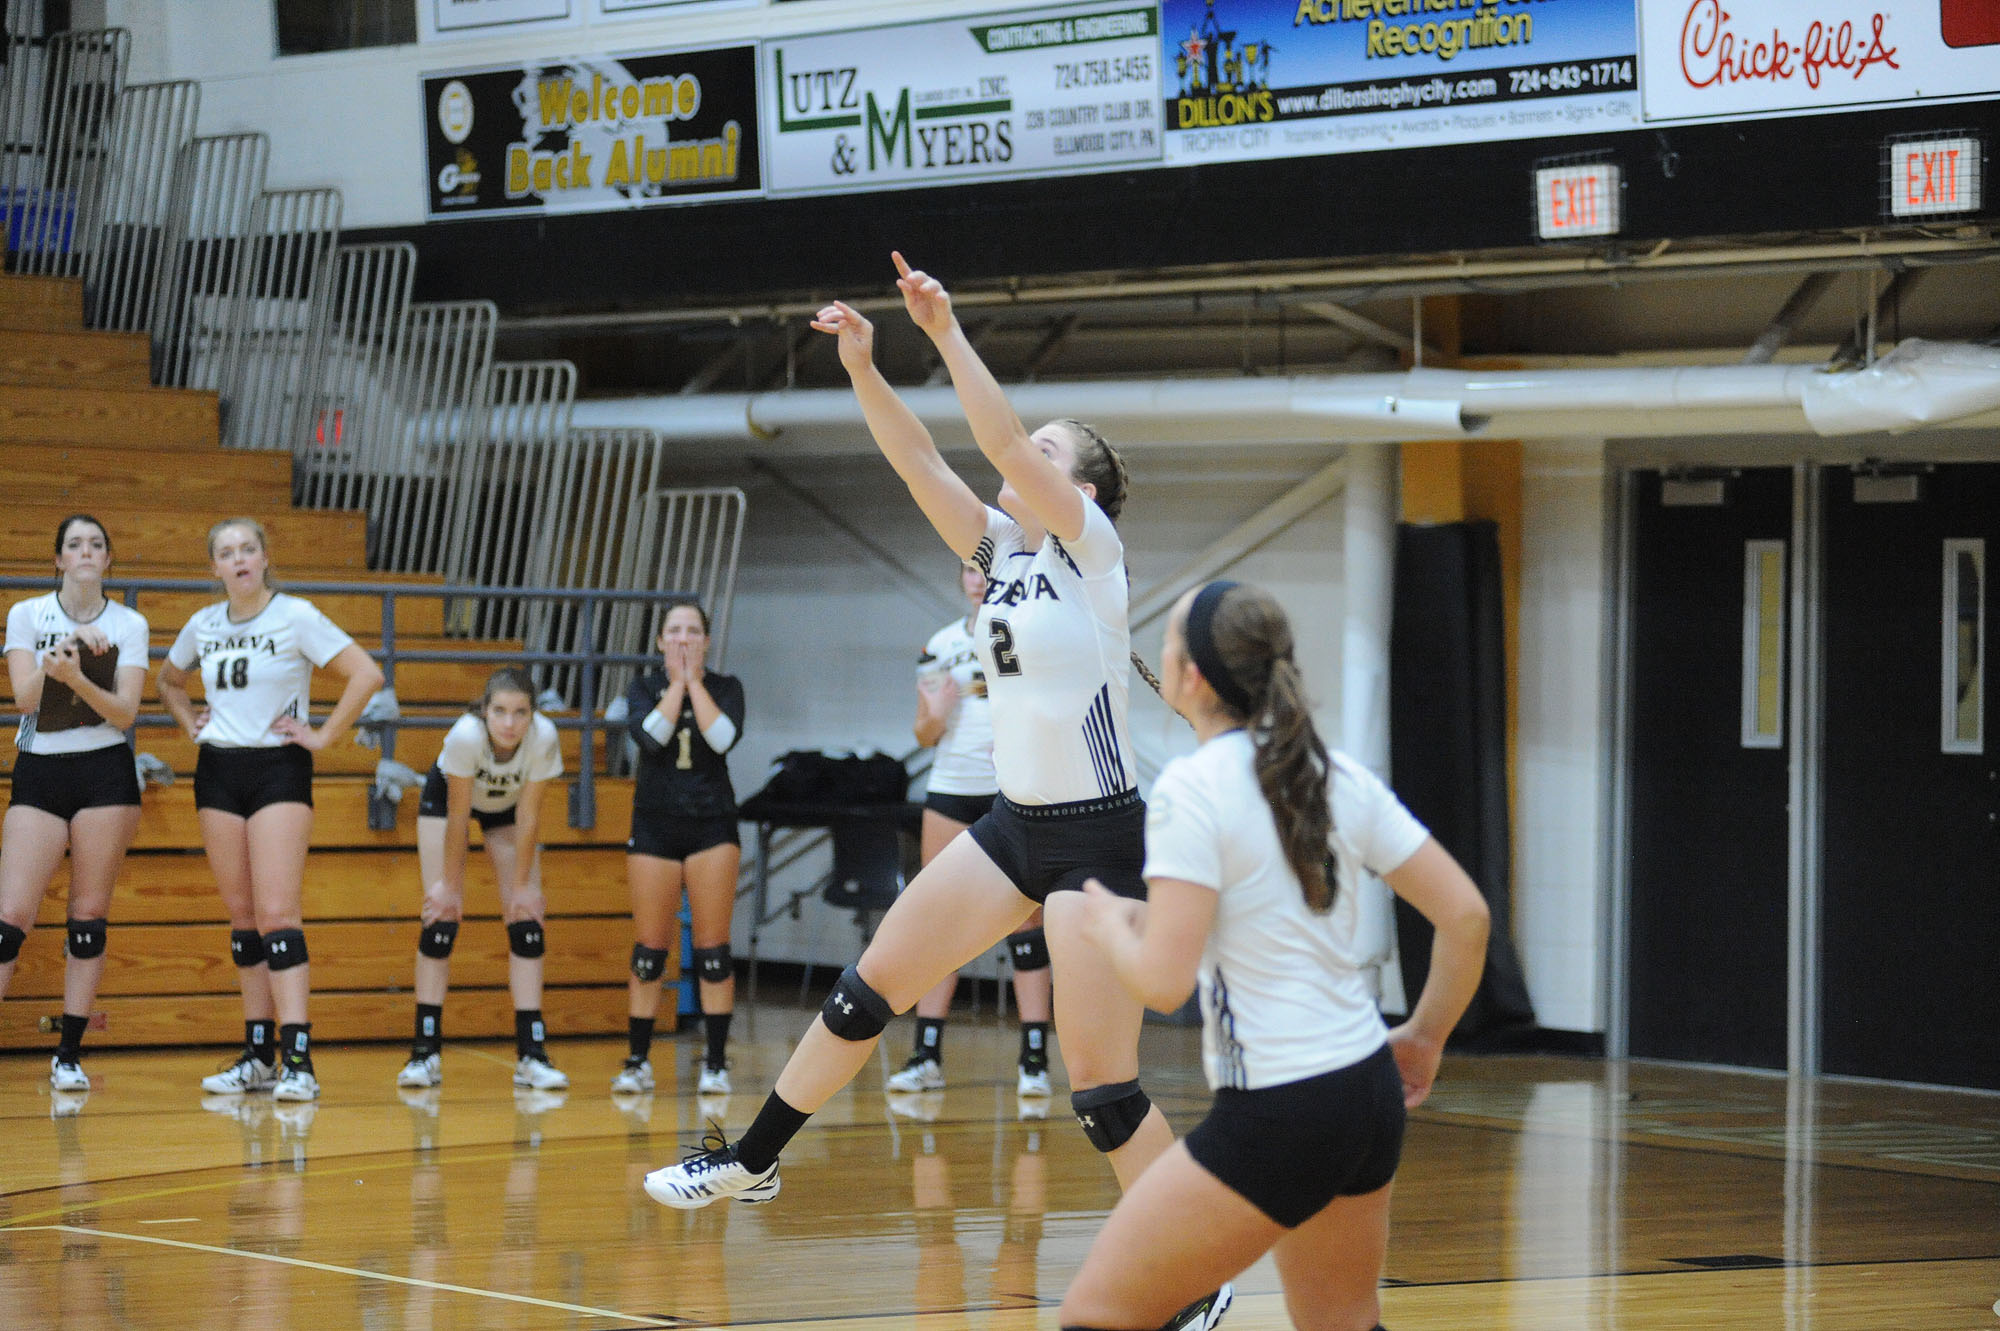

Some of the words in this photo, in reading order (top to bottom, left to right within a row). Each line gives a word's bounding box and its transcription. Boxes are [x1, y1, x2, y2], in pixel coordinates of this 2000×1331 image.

[1075, 11, 1149, 41] ENGINEERING
[1367, 6, 1532, 60] Recognition
[1681, 0, 1899, 88] Chick-fil-A
[536, 72, 698, 127] Welcome
[775, 48, 861, 133] LUTZ
[1048, 105, 1099, 127] COUNTRY
[1104, 101, 1131, 122] CLUB
[1178, 91, 1274, 129] DILLON'S
[1277, 78, 1498, 114] www.dillonstrophycity.com
[510, 140, 592, 193] Back
[605, 124, 738, 186] Alumni
[831, 134, 857, 176] &
[866, 88, 1014, 171] MYERS
[1181, 132, 1236, 153] TROPHY
[1238, 128, 1271, 149] CITY
[1550, 176, 1597, 228] EXIT
[1904, 150, 1959, 205] EXIT
[216, 656, 249, 690] 18
[989, 617, 1022, 677] 2
[675, 726, 693, 770] 1
